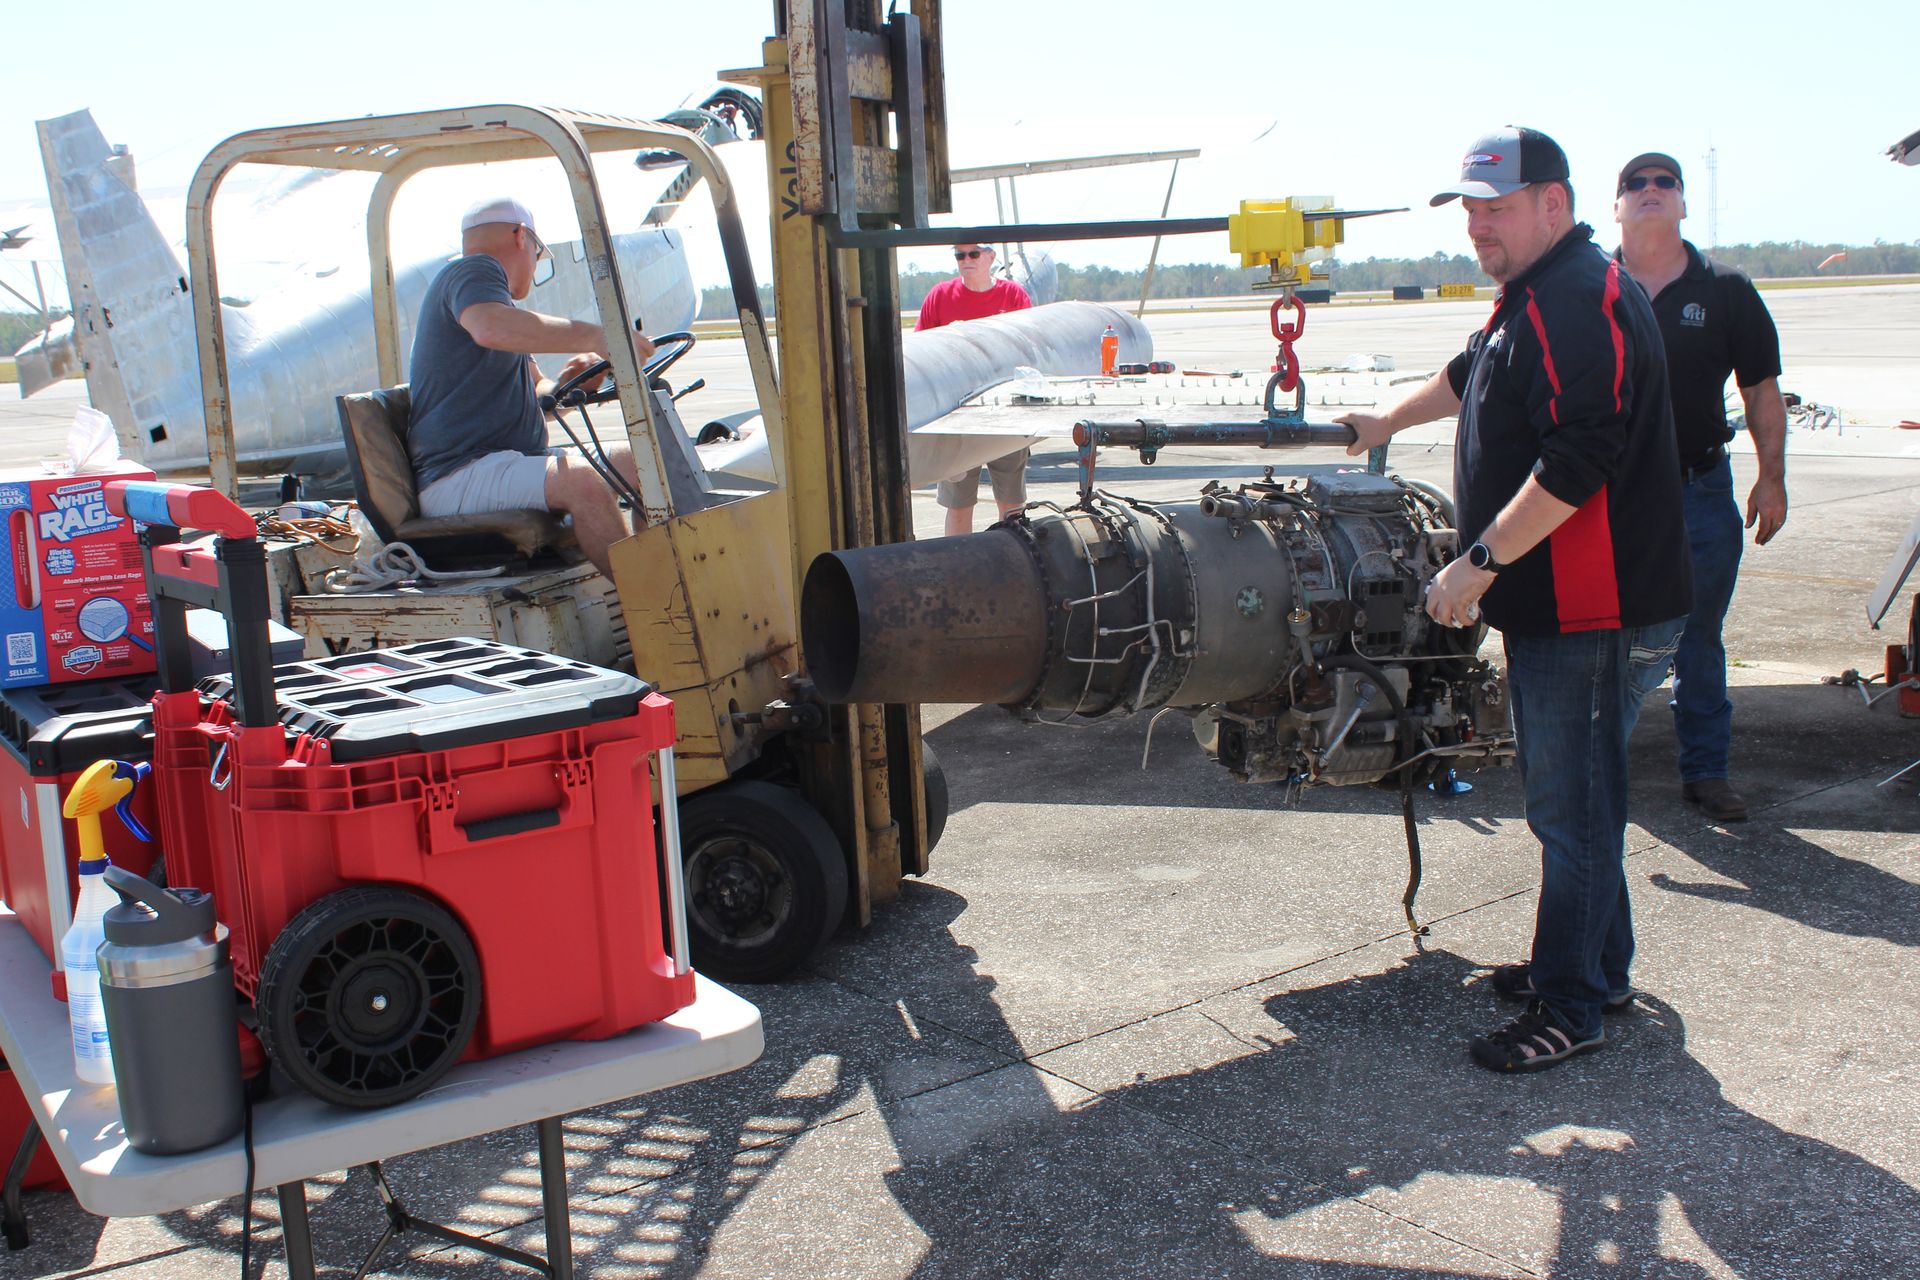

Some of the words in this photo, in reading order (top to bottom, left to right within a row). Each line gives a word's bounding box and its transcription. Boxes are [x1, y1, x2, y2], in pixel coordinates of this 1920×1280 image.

[0, 495, 25, 505] OX
[48, 490, 104, 510] WHITE
[66, 653, 99, 666] Sanitized
[9, 667, 37, 678] SELLARS
